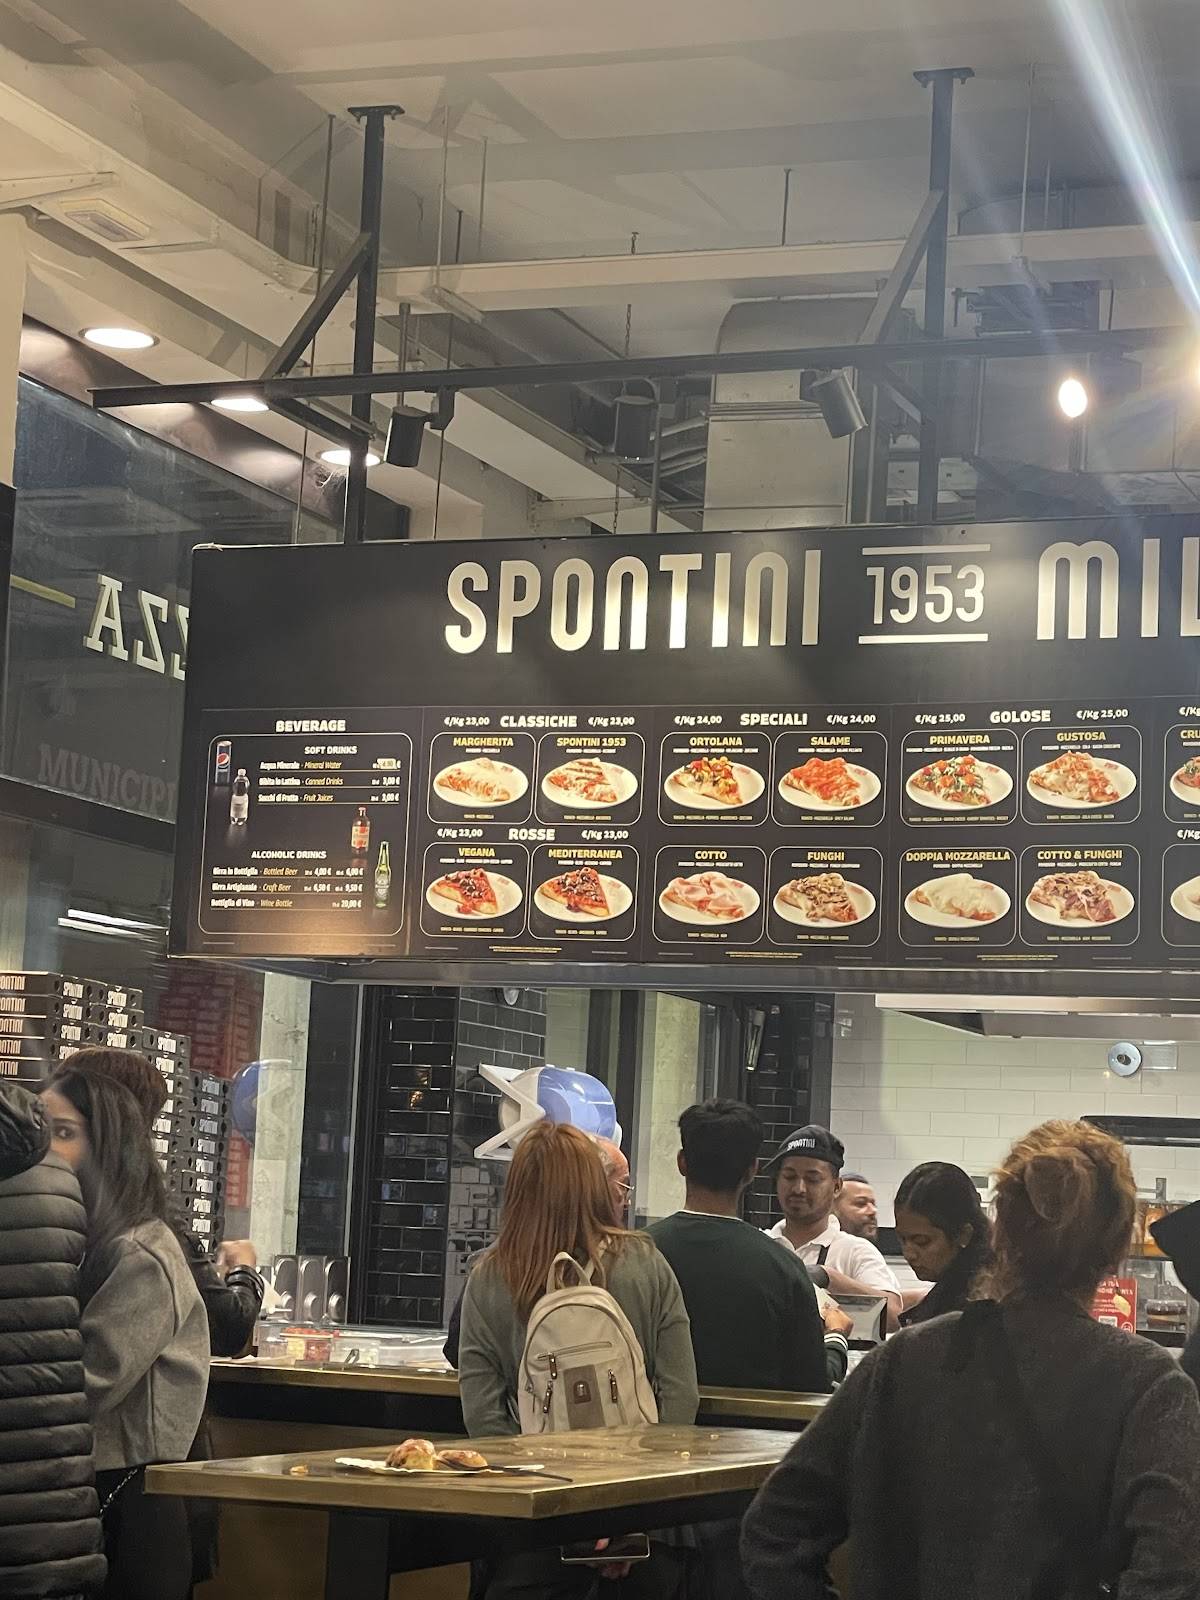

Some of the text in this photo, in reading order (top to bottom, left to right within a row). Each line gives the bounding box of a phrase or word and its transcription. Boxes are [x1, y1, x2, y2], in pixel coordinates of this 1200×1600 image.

[445, 548, 821, 655] SPONTINI
[865, 564, 987, 625] 1953
[849, 714, 876, 724] 24,00
[938, 713, 966, 723] 25,00
[989, 710, 1051, 724] GOLOSE
[1100, 709, 1129, 719] 25,00
[465, 716, 490, 726] 23,00
[500, 715, 578, 728] CLASSICHE
[610, 716, 635, 726] 23,00
[696, 715, 722, 725] 24,00
[739, 713, 808, 726] SPECIALI
[275, 720, 346, 732] BEVERAGE
[453, 737, 514, 747] MARGHERITA
[556, 737, 627, 747] SPONTINI 1953
[689, 736, 743, 746] ORTOLANA
[810, 736, 851, 746] SALAME
[929, 734, 990, 745] PRIMAVERA
[1056, 732, 1106, 742] GUSTOSA
[304, 745, 358, 755] SOFT DRINKS
[458, 828, 483, 838] 23,00
[508, 828, 556, 841] ROSSE
[603, 830, 629, 840] 23,00
[252, 850, 327, 859] ALCOHOLIC DRINKS
[458, 848, 496, 858] VEGANA
[548, 849, 623, 859] MEDITERRANEA
[694, 850, 728, 860] COTTO
[807, 852, 845, 861] FUNGHI
[906, 851, 1011, 862] DOPPIA MOZZARELLA
[1037, 850, 1123, 860] COTTO & FUNGHI
